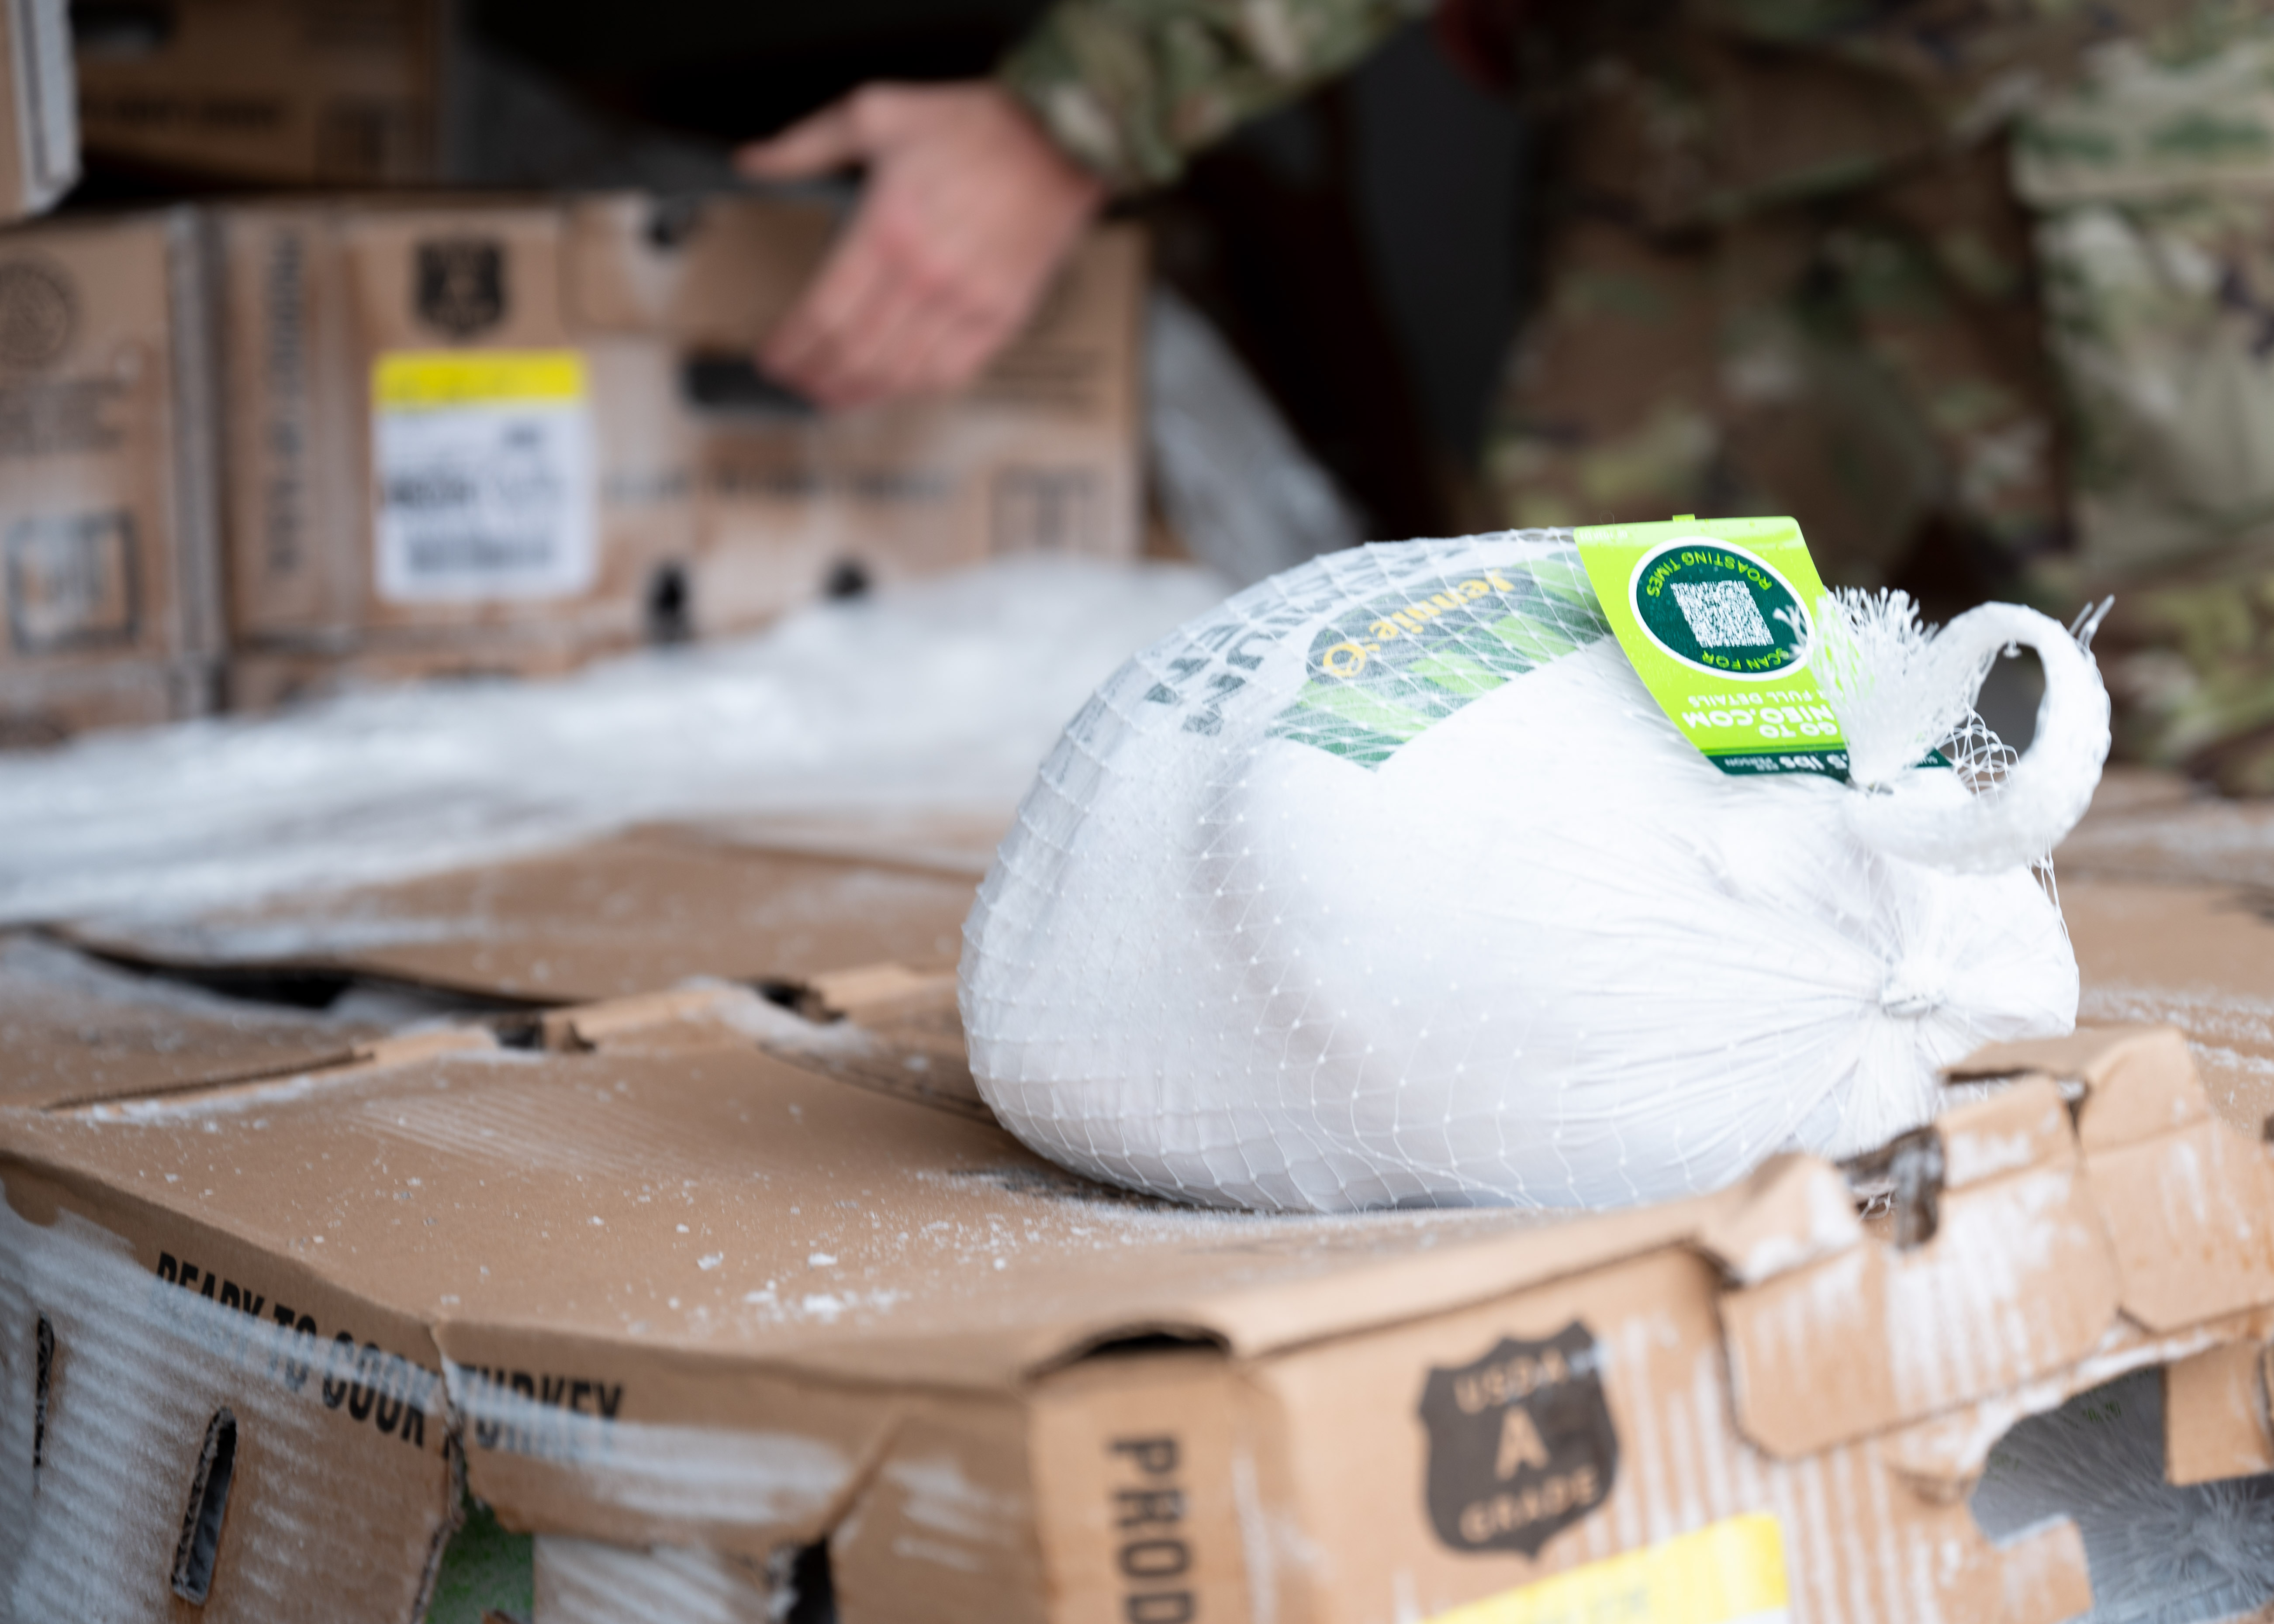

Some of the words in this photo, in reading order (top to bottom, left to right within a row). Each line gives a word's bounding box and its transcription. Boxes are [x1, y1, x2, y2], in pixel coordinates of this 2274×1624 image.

[1647, 558, 1681, 597] TIMES
[1681, 551, 1773, 590] ROASTING
[1702, 650, 1742, 669] FOR
[1746, 648, 1789, 670] SCAN
[1688, 692, 1764, 708] DETAILS
[1766, 690, 1812, 703] FULL
[1682, 704, 1835, 728] NIEO.COM
[1759, 724, 1797, 738] TO
[1800, 721, 1838, 736] GO
[1779, 755, 1825, 770] lbs
[1826, 754, 1848, 769] .5
[1454, 1347, 1570, 1415] USDA
[1493, 1403, 1551, 1481] A
[1458, 1464, 1600, 1545] GRADE
